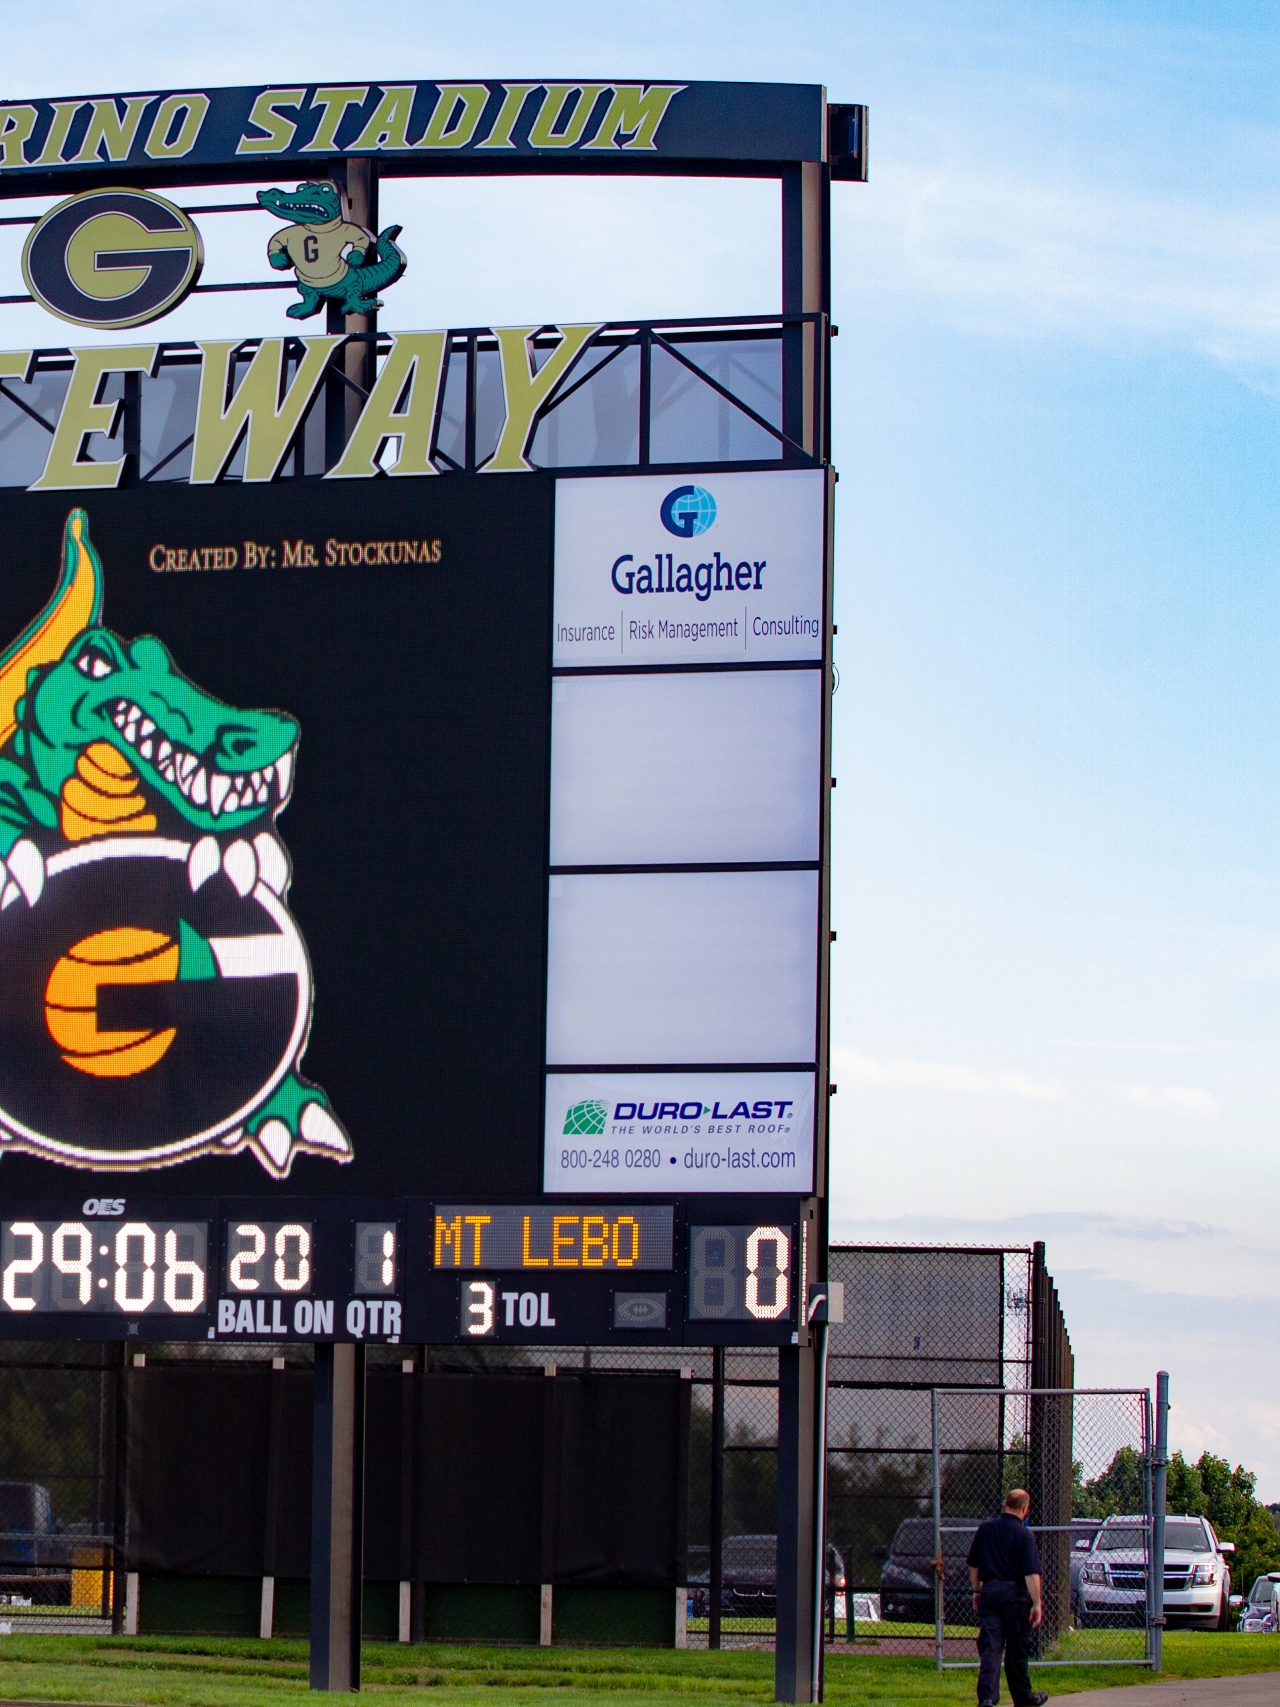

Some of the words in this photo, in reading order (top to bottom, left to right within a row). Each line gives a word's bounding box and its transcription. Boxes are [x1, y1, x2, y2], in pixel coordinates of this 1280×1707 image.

[235, 83, 689, 155] STADIUM
[28, 192, 194, 324] G
[303, 235, 320, 264] G
[611, 551, 767, 602] Gallagher
[557, 623, 615, 642] Insurance
[629, 620, 655, 639] Risk
[658, 618, 738, 642] Management
[752, 615, 819, 638] Consulting
[611, 1125, 635, 1135] THE
[642, 1124, 701, 1134] WORLD'S
[707, 1124, 742, 1134] BEST
[561, 1149, 620, 1168] 800-248
[625, 1149, 661, 1168] 0280
[684, 1147, 796, 1169] duro-last.com
[82, 1198, 126, 1216] OES
[229, 1224, 311, 1291] 20
[381, 1229, 396, 1288] 1
[434, 1215, 492, 1266] MT
[522, 1215, 640, 1267] LEBO
[2, 1221, 206, 1313] 29:06
[745, 1226, 790, 1320] 0
[217, 1300, 288, 1334] BALL
[293, 1300, 334, 1334] ON
[346, 1300, 402, 1338] QTR
[467, 1282, 494, 1336] 3
[501, 1292, 556, 1327] TOL
